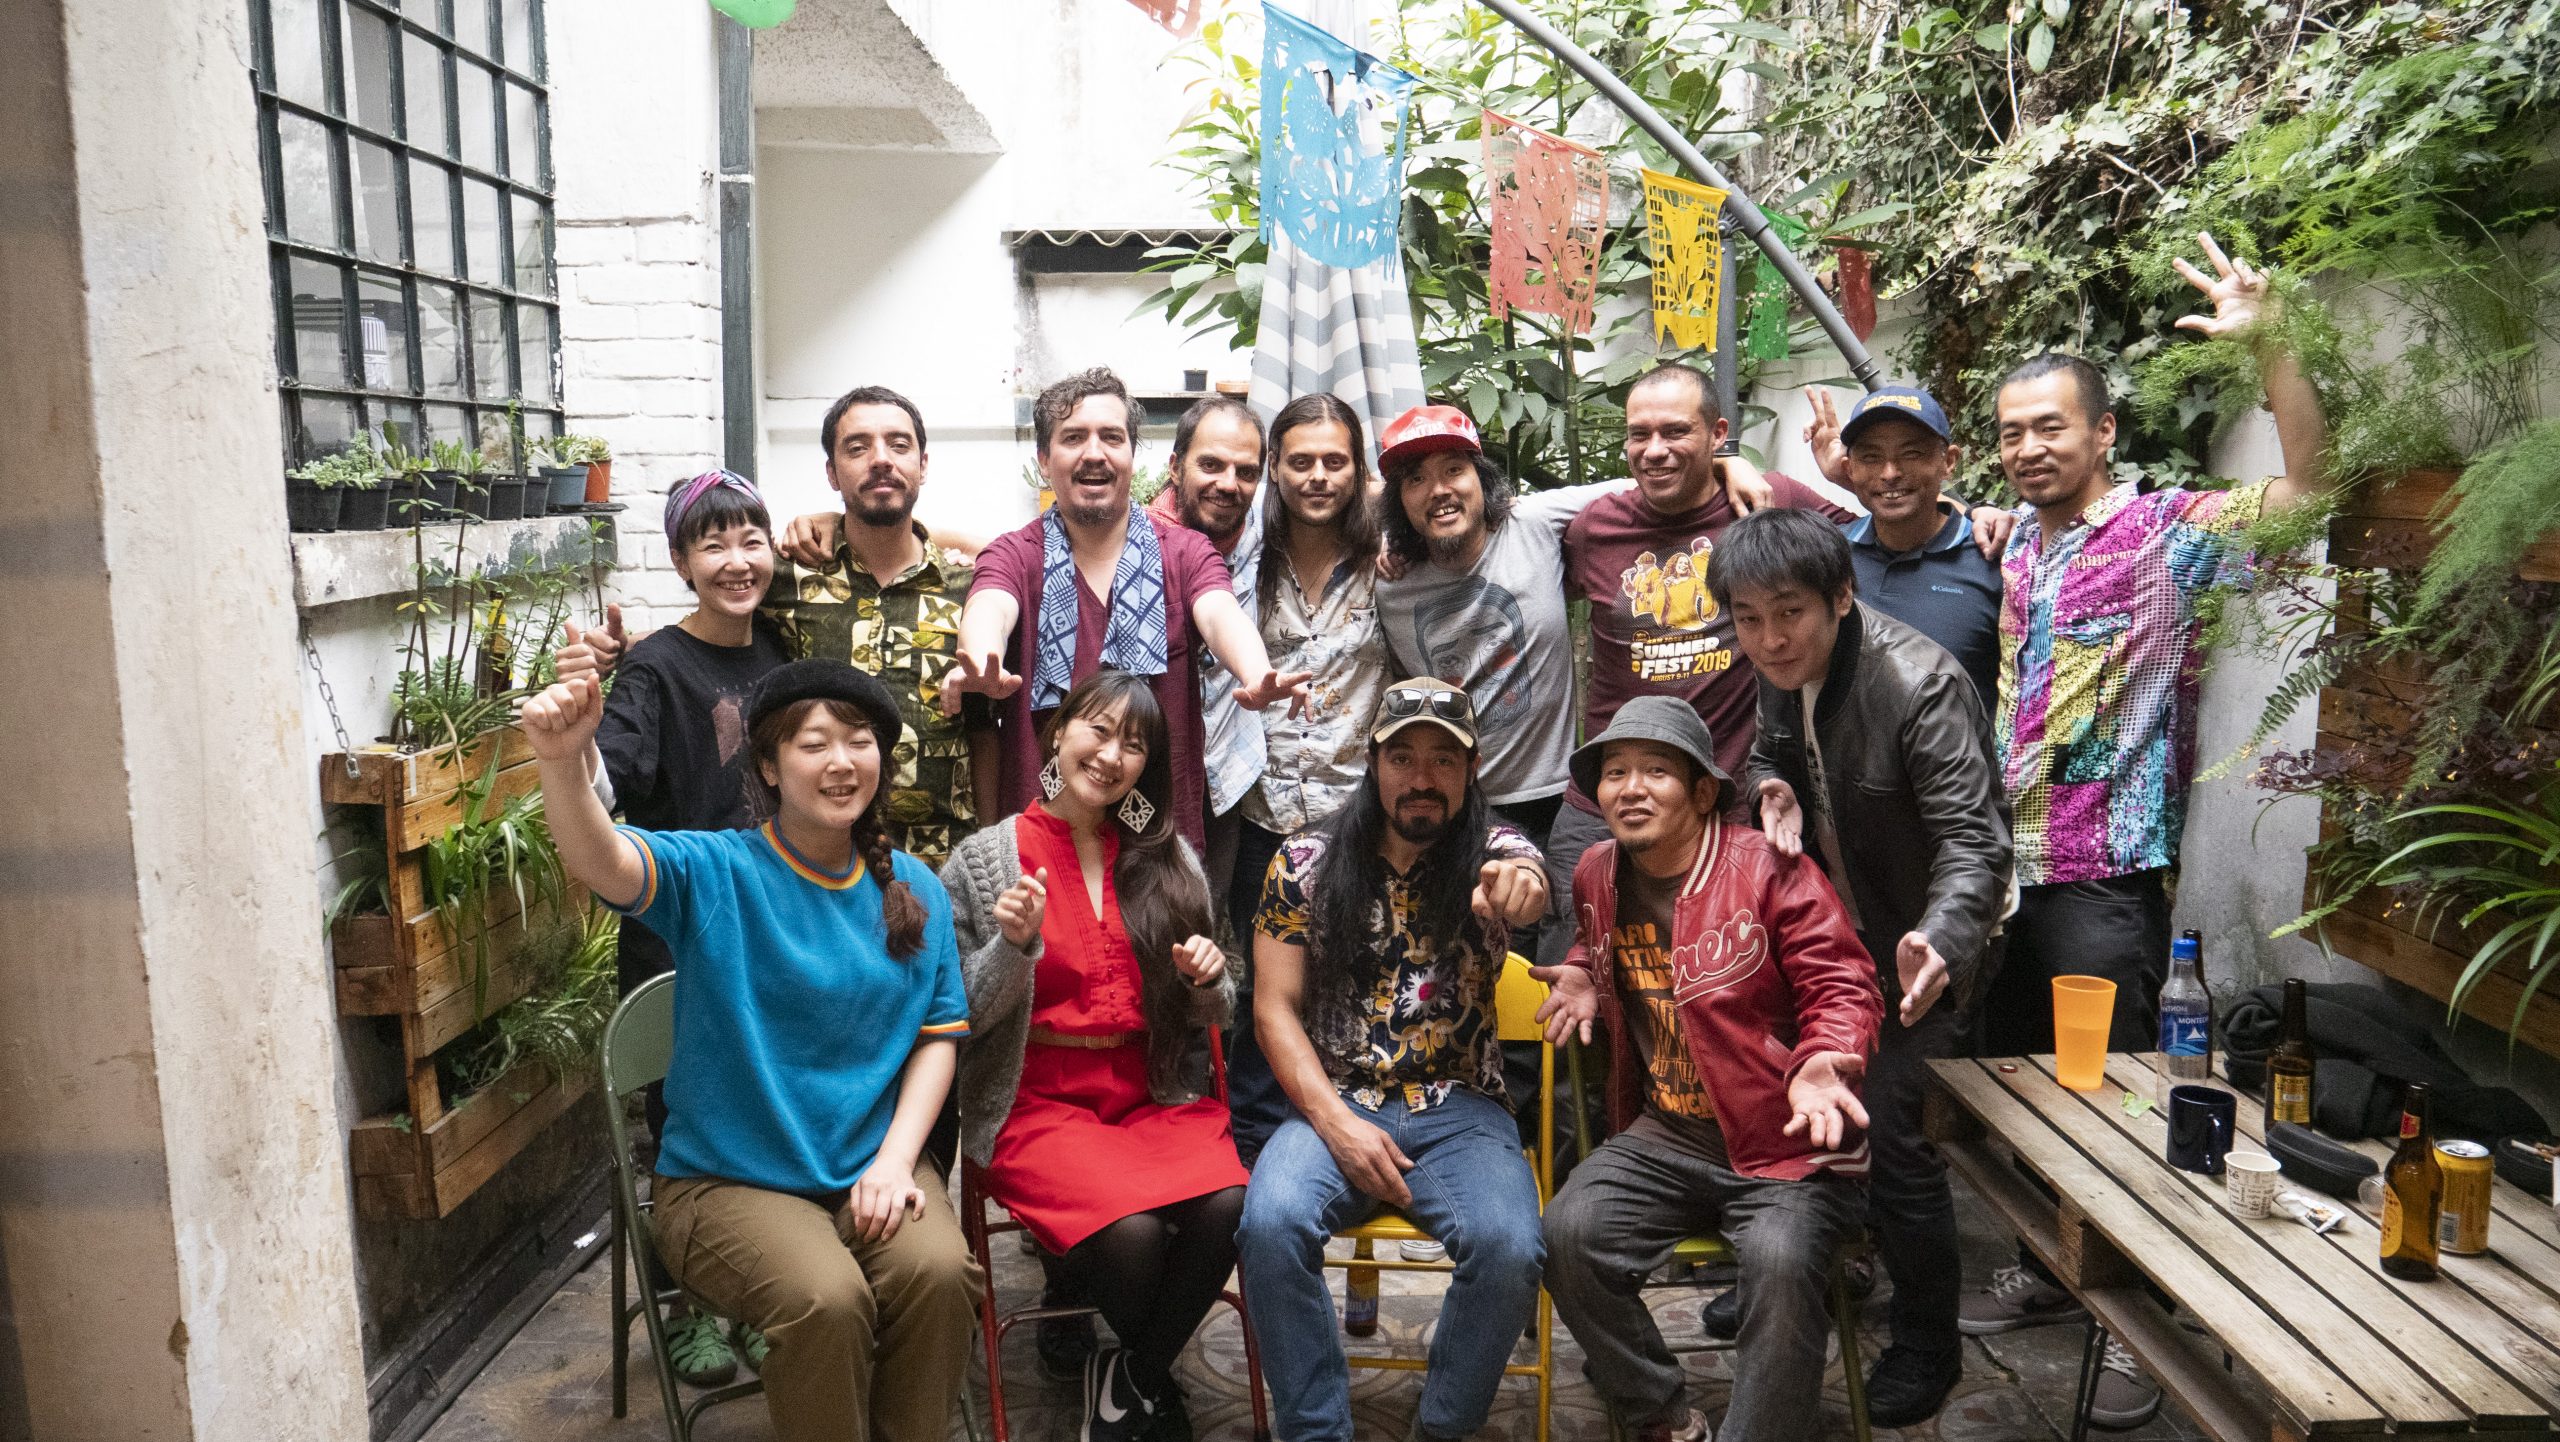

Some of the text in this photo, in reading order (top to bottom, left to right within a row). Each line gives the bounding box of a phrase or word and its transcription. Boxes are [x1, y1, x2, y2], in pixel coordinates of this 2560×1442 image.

[1630, 637, 1720, 659] SUMMER
[1641, 656, 1694, 679] FEST
[1692, 649, 1732, 675] 2019
[1650, 673, 1676, 682] AUGUST
[2178, 1016, 2209, 1025] MONTE
